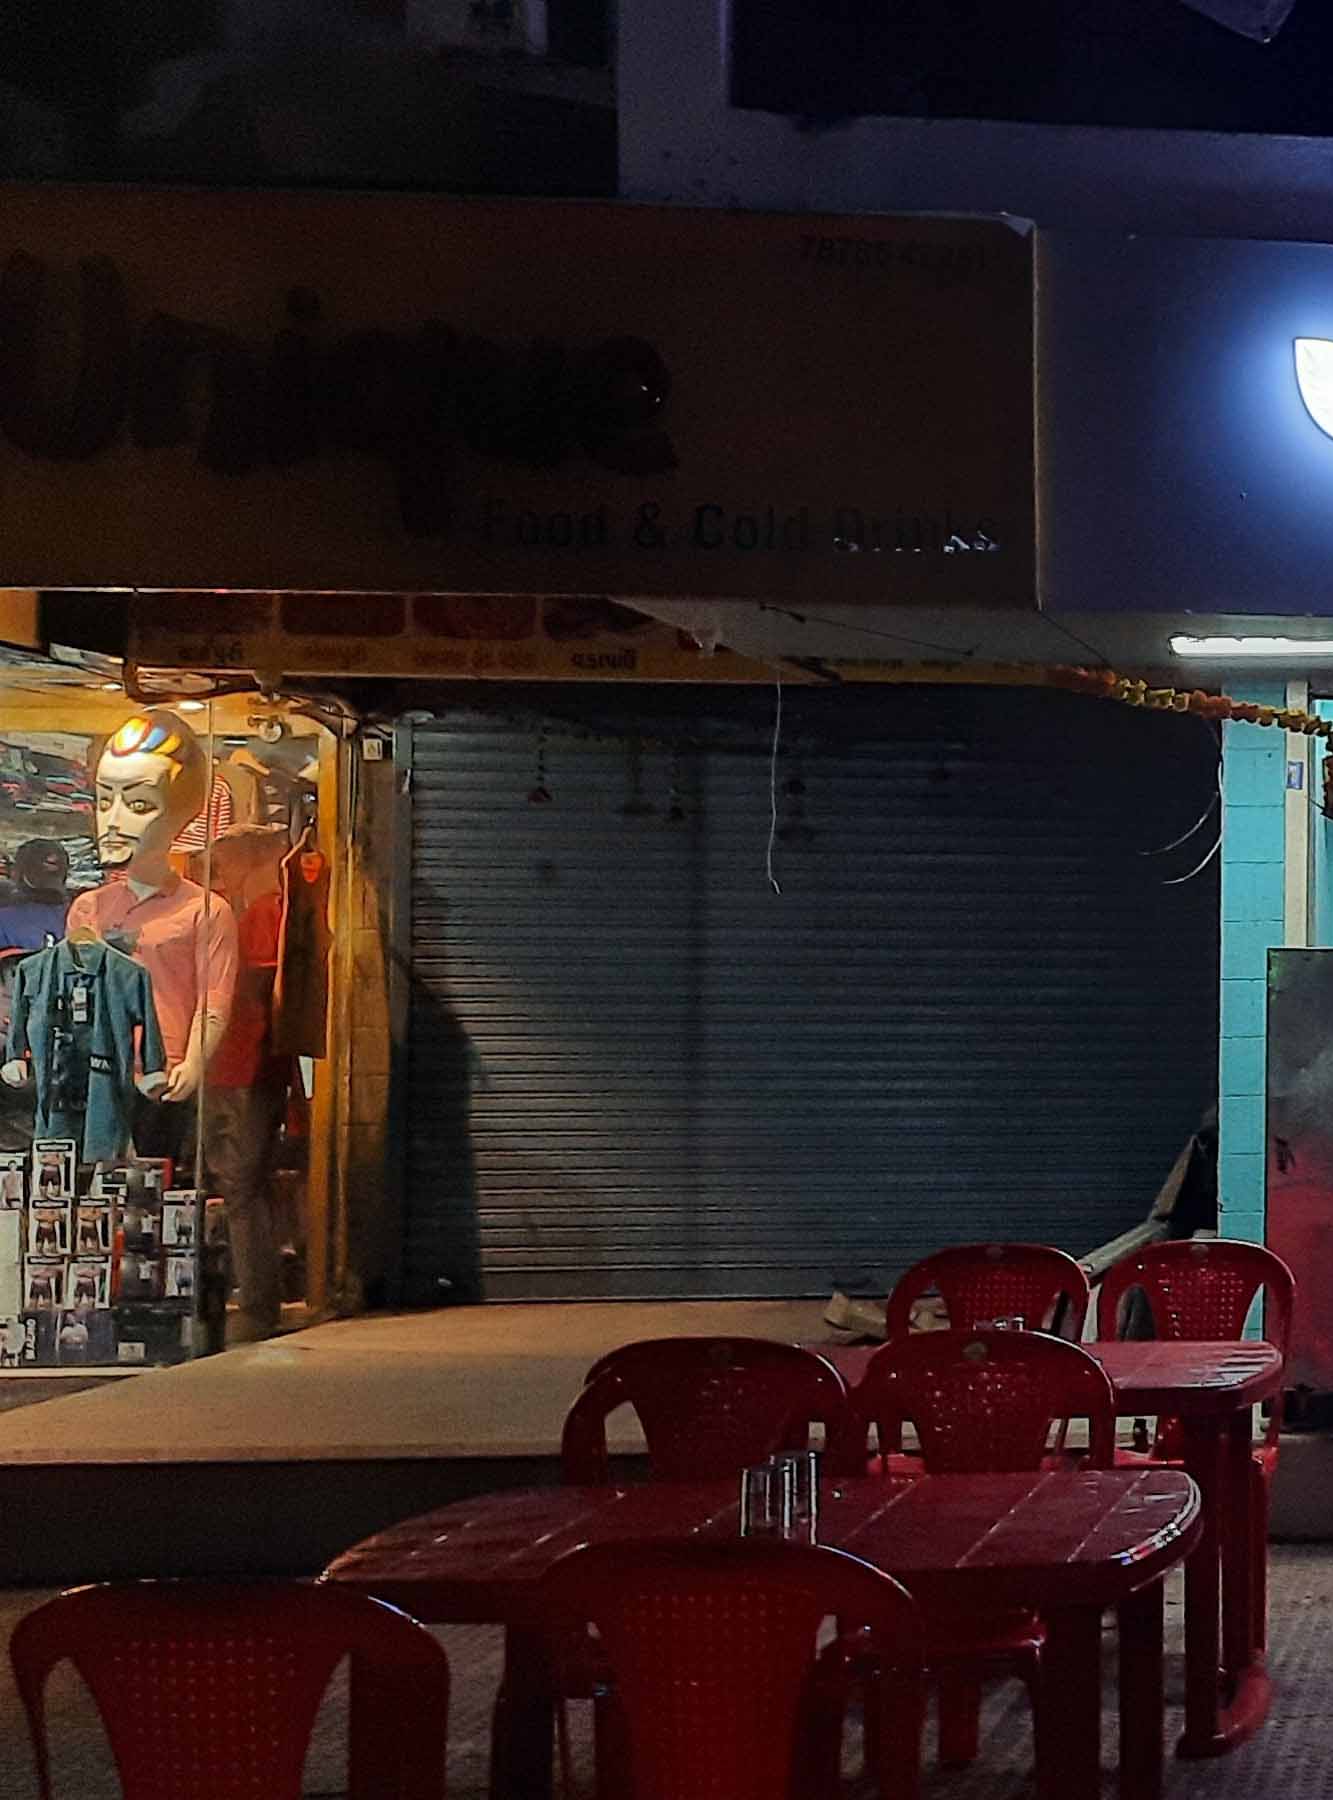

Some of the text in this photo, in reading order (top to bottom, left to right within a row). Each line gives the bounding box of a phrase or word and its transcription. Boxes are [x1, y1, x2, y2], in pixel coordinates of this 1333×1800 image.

[482, 499, 1001, 553] Food & Cold Drinks
